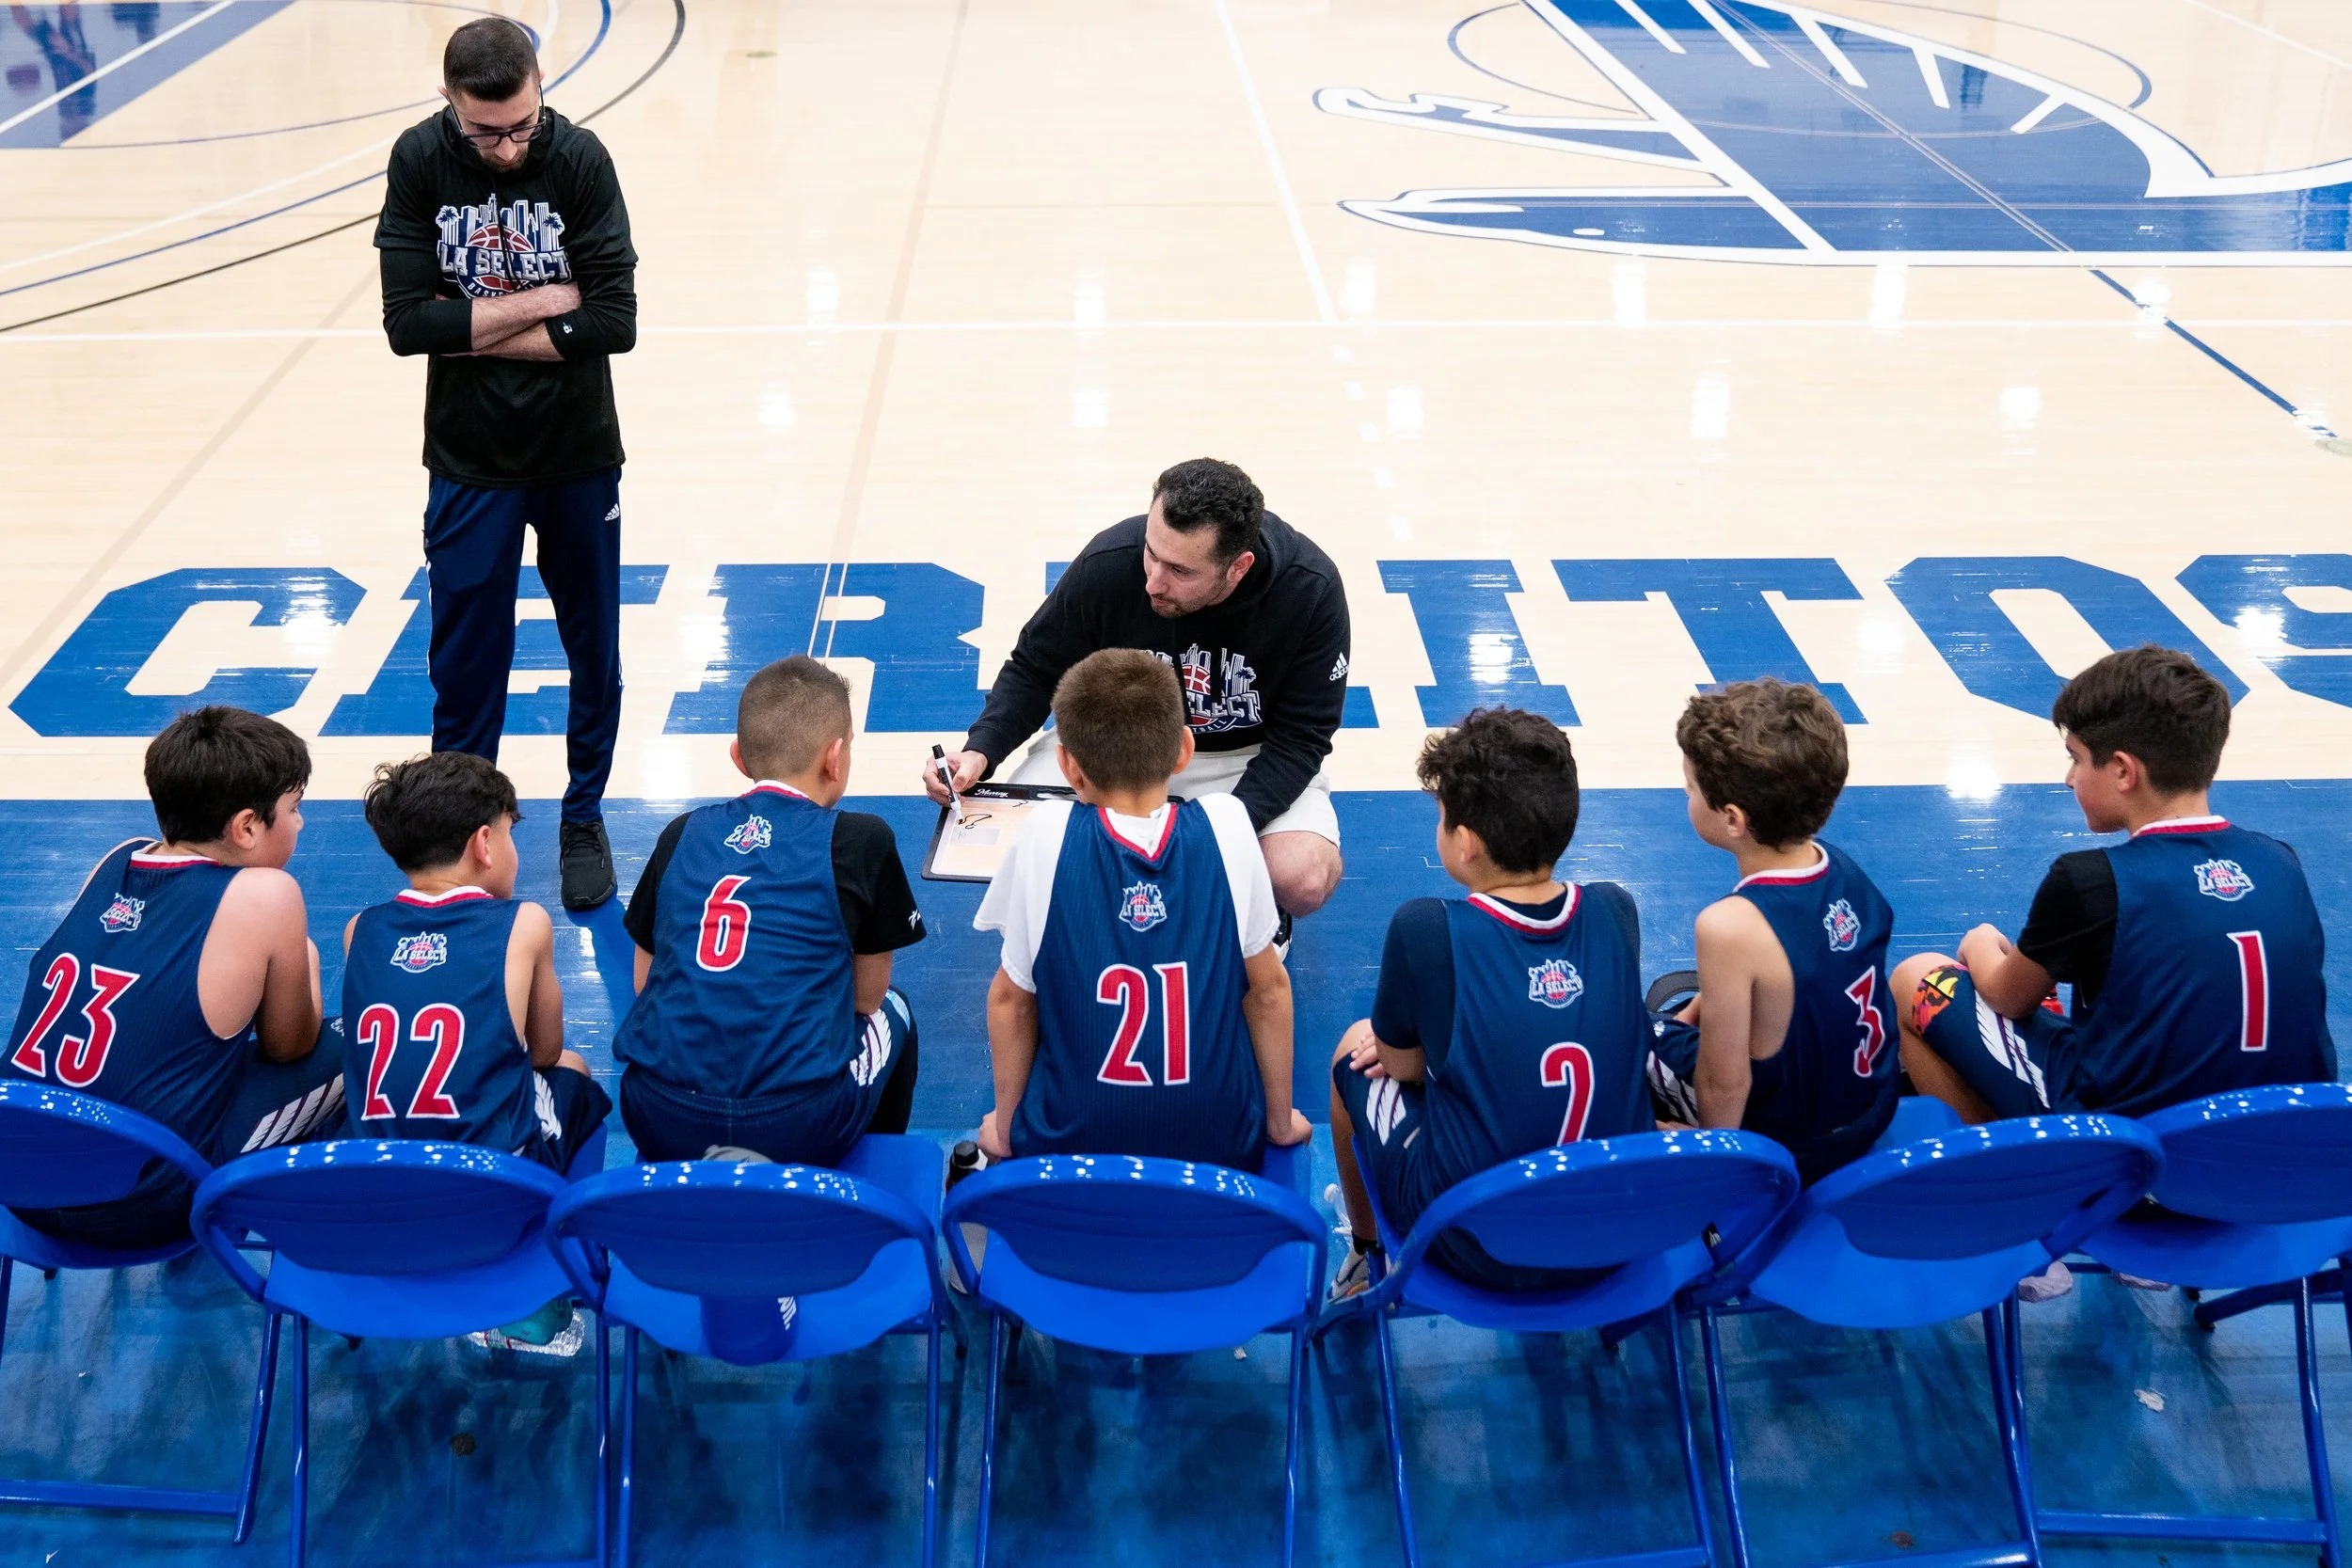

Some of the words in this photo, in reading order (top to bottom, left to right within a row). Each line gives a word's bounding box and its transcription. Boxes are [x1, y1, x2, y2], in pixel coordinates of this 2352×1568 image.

[439, 243, 469, 276] LA
[475, 248, 568, 280] SELECT
[9, 553, 2352, 736] CERITOS
[1185, 690, 1259, 722] ELECT
[975, 788, 1009, 798] Murray
[409, 949, 446, 961] SELECT
[696, 874, 752, 973] 6
[10, 952, 140, 1088] 23
[1096, 961, 1190, 1086] 21
[1845, 965, 1885, 1078] 3
[2226, 930, 2269, 1052] 1
[357, 1003, 465, 1121] 22
[1541, 1042, 1595, 1147] 2
